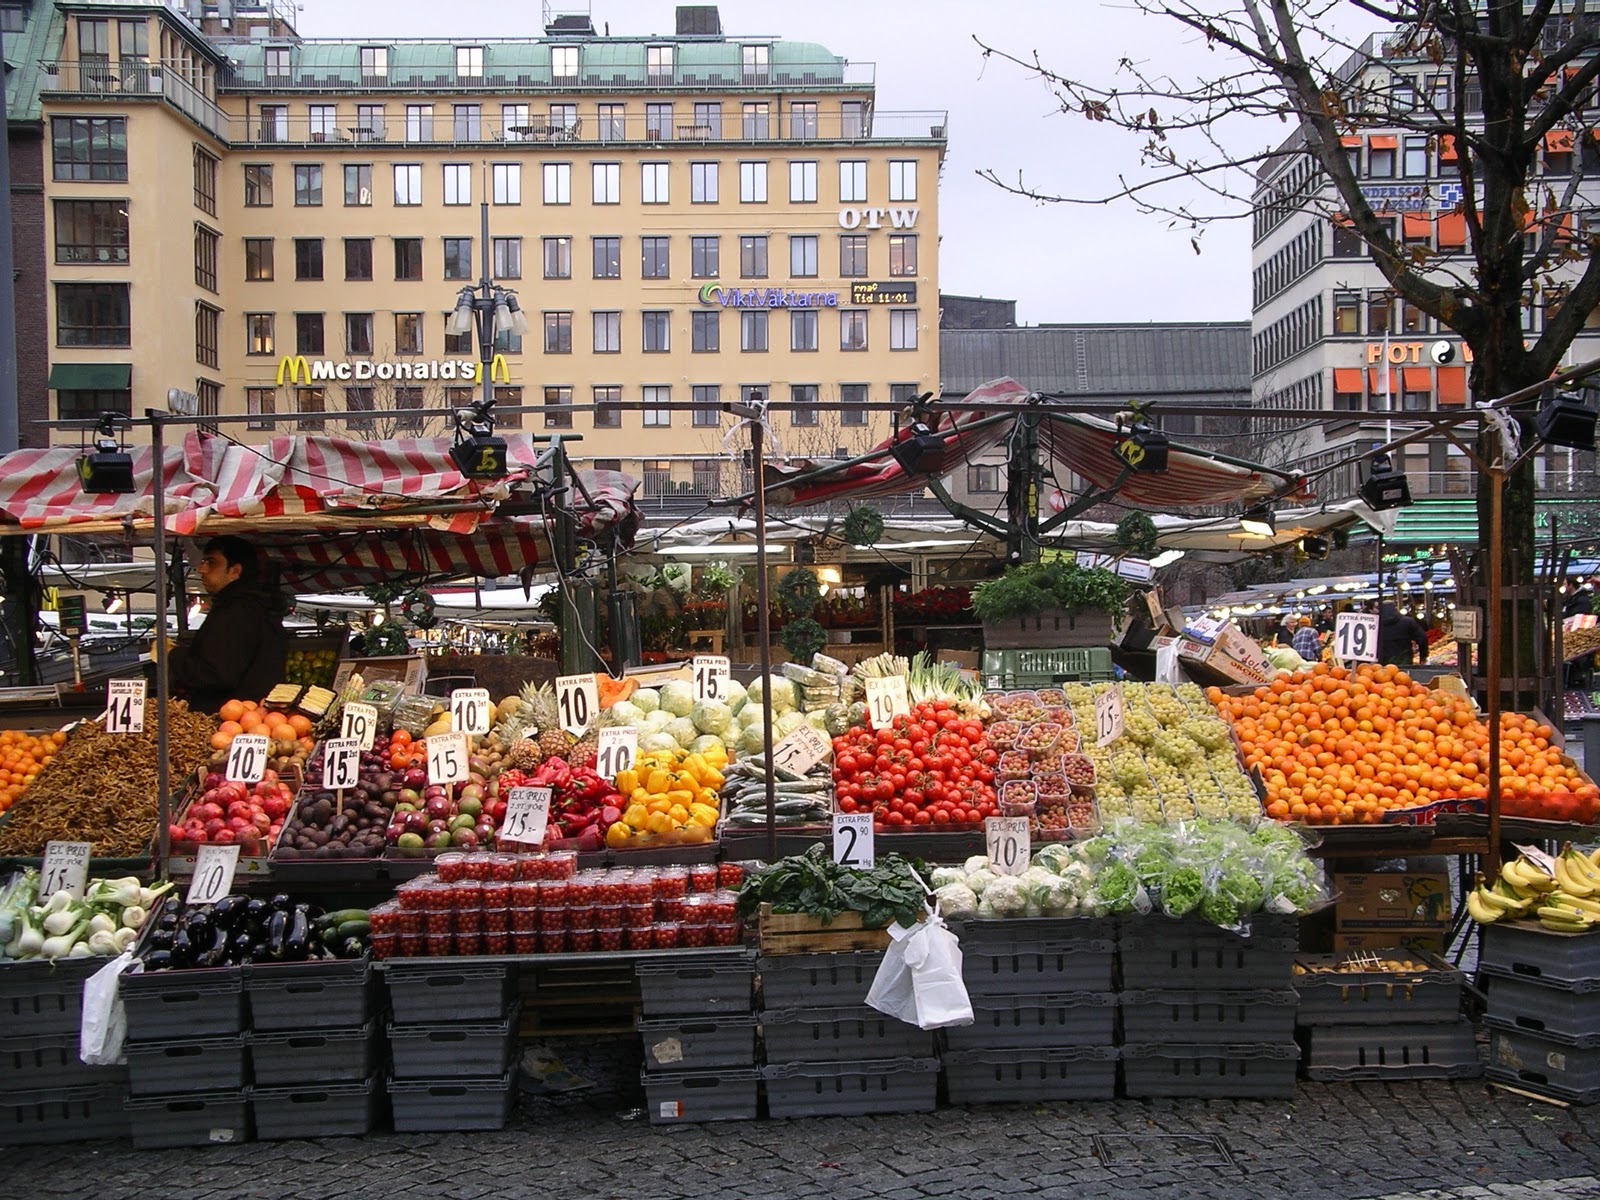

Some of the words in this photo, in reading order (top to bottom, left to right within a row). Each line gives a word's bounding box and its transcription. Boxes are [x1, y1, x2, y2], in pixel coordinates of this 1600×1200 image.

[1361, 186, 1424, 198] NDERSSO
[838, 207, 920, 230] OTW
[716, 286, 839, 308] ViktVäktarna
[854, 293, 874, 303] Tid
[1367, 341, 1424, 364] HOT
[311, 360, 477, 381] McDonald's
[1338, 622, 1367, 657] 19
[696, 667, 717, 700] 15
[109, 697, 131, 731] 14
[133, 698, 143, 706] 90
[347, 704, 364, 714] EXTRA
[364, 708, 376, 717] PRIS
[455, 700, 477, 732] 10
[560, 686, 588, 728] 10
[873, 694, 893, 723] 19
[345, 713, 367, 746] 19
[367, 718, 375, 728] 90
[431, 736, 449, 745] EXTRA
[449, 733, 462, 741] PRIS
[601, 730, 621, 738] EXTRA
[328, 741, 345, 749] EXTRA
[232, 746, 255, 779] 10
[326, 750, 348, 786] 15
[348, 749, 358, 758] 2st
[600, 745, 631, 777] 10
[526, 790, 548, 803] PRIS
[837, 816, 856, 824] EXTRA
[856, 815, 870, 823] PRIS
[1006, 821, 1026, 834] PRIS
[66, 845, 88, 858] PRIS
[838, 825, 860, 865] 2
[859, 826, 869, 836] 90
[862, 859, 872, 868] Hg
[191, 864, 224, 900] 10
